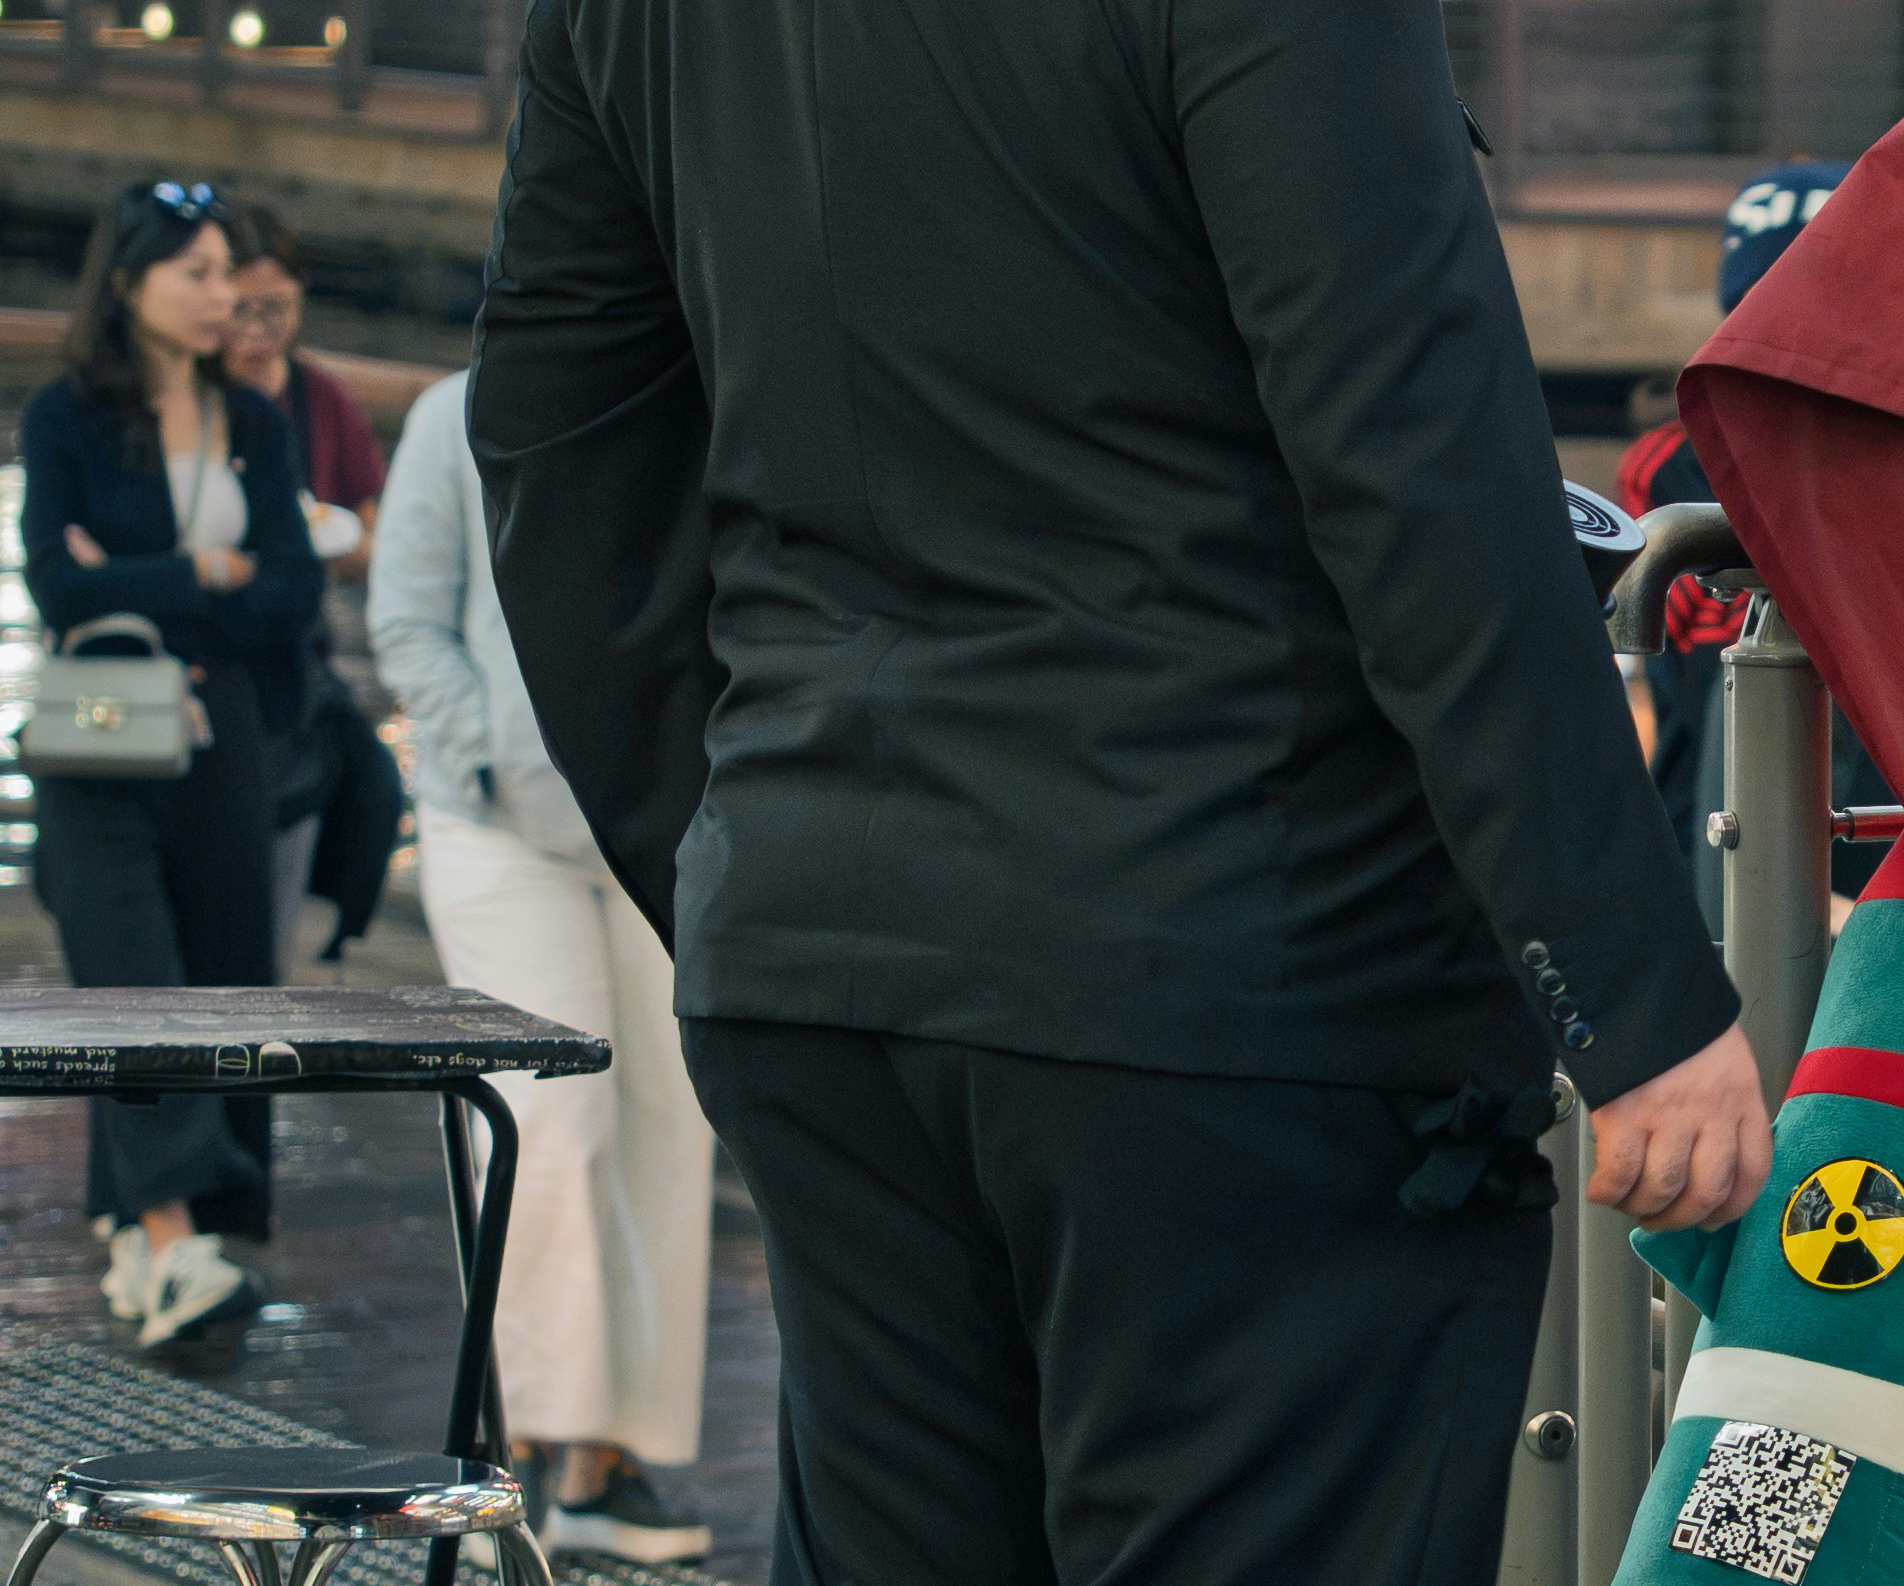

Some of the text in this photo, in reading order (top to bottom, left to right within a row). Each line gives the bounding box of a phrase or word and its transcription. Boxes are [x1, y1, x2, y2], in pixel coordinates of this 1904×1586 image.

[84, 1048, 116, 1060] and
[449, 1052, 486, 1067] dogs
[13, 1060, 48, 1071] such
[55, 1057, 116, 1073] spreads
